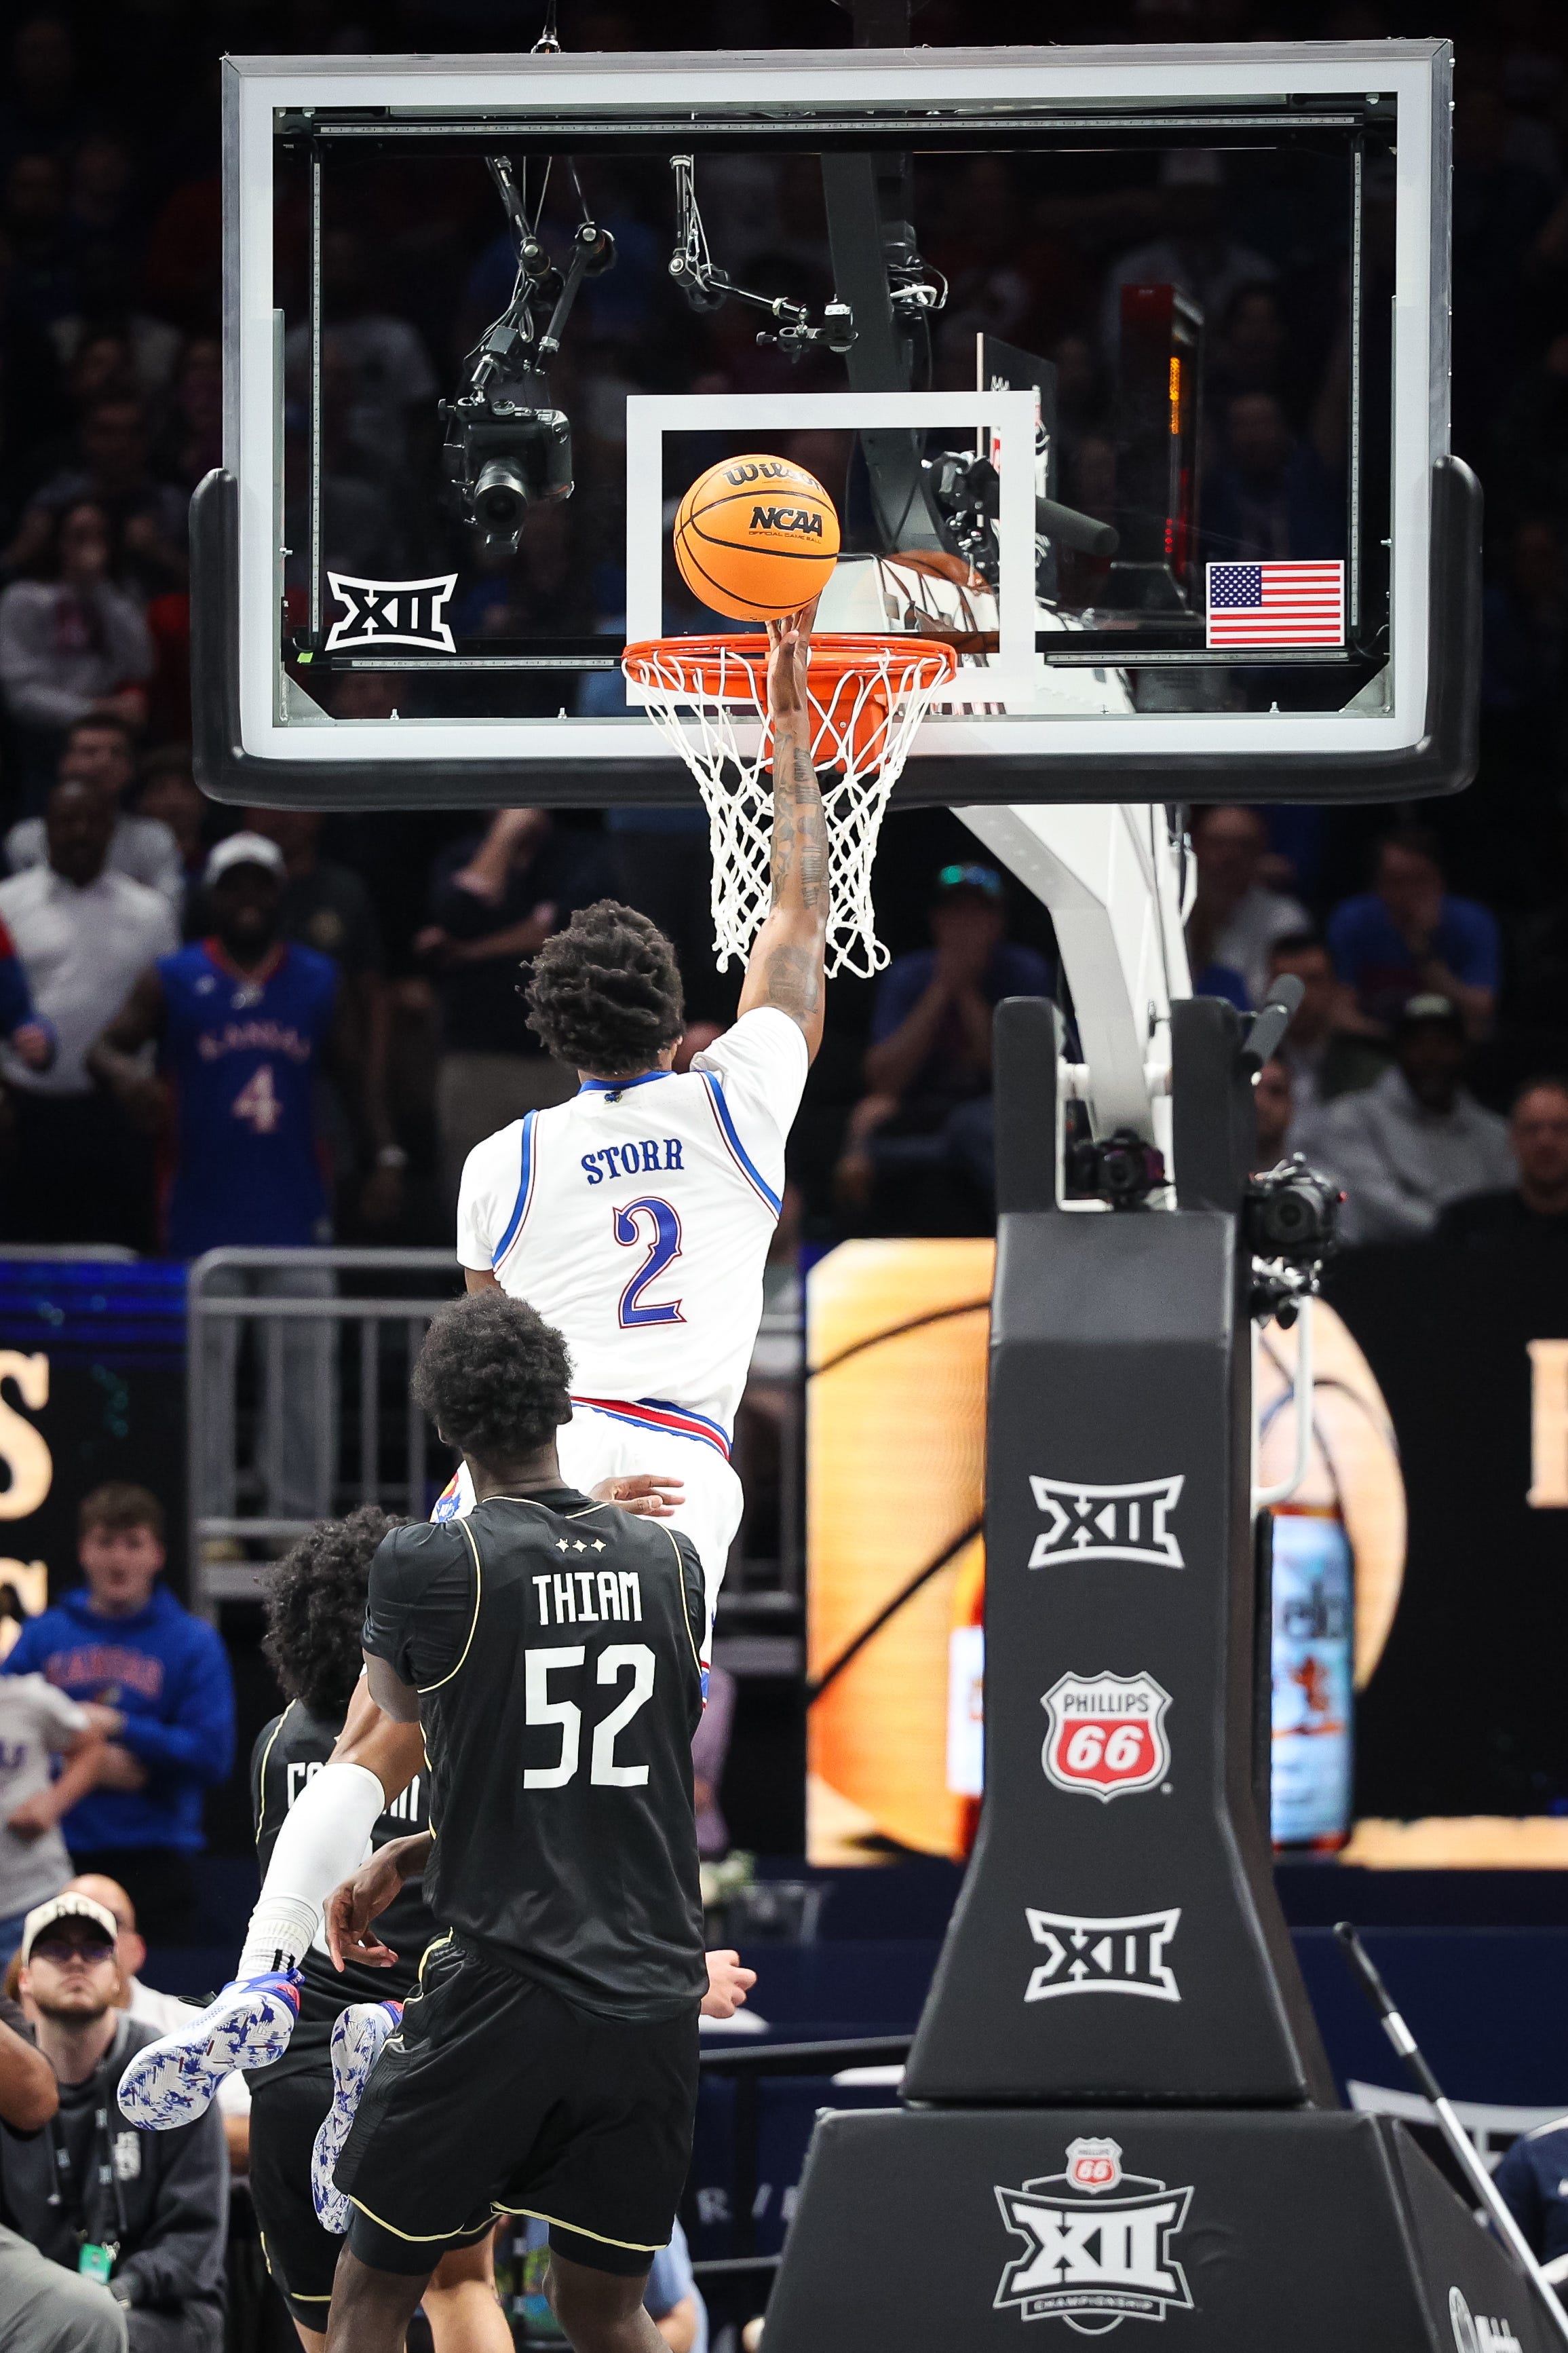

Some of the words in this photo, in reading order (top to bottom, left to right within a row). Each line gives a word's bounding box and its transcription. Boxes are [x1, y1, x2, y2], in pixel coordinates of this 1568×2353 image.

[749, 506, 822, 538] NCAA
[231, 1064, 282, 1134] 4
[581, 1138, 684, 1185] STORR
[613, 1196, 687, 1329] 2
[533, 1571, 643, 1626] THIAM
[523, 1643, 656, 1790] 52
[1063, 1693, 1149, 1712] PHILLIPS
[1066, 1724, 1145, 1771] 66
[1011, 2202, 1177, 2293] XII
